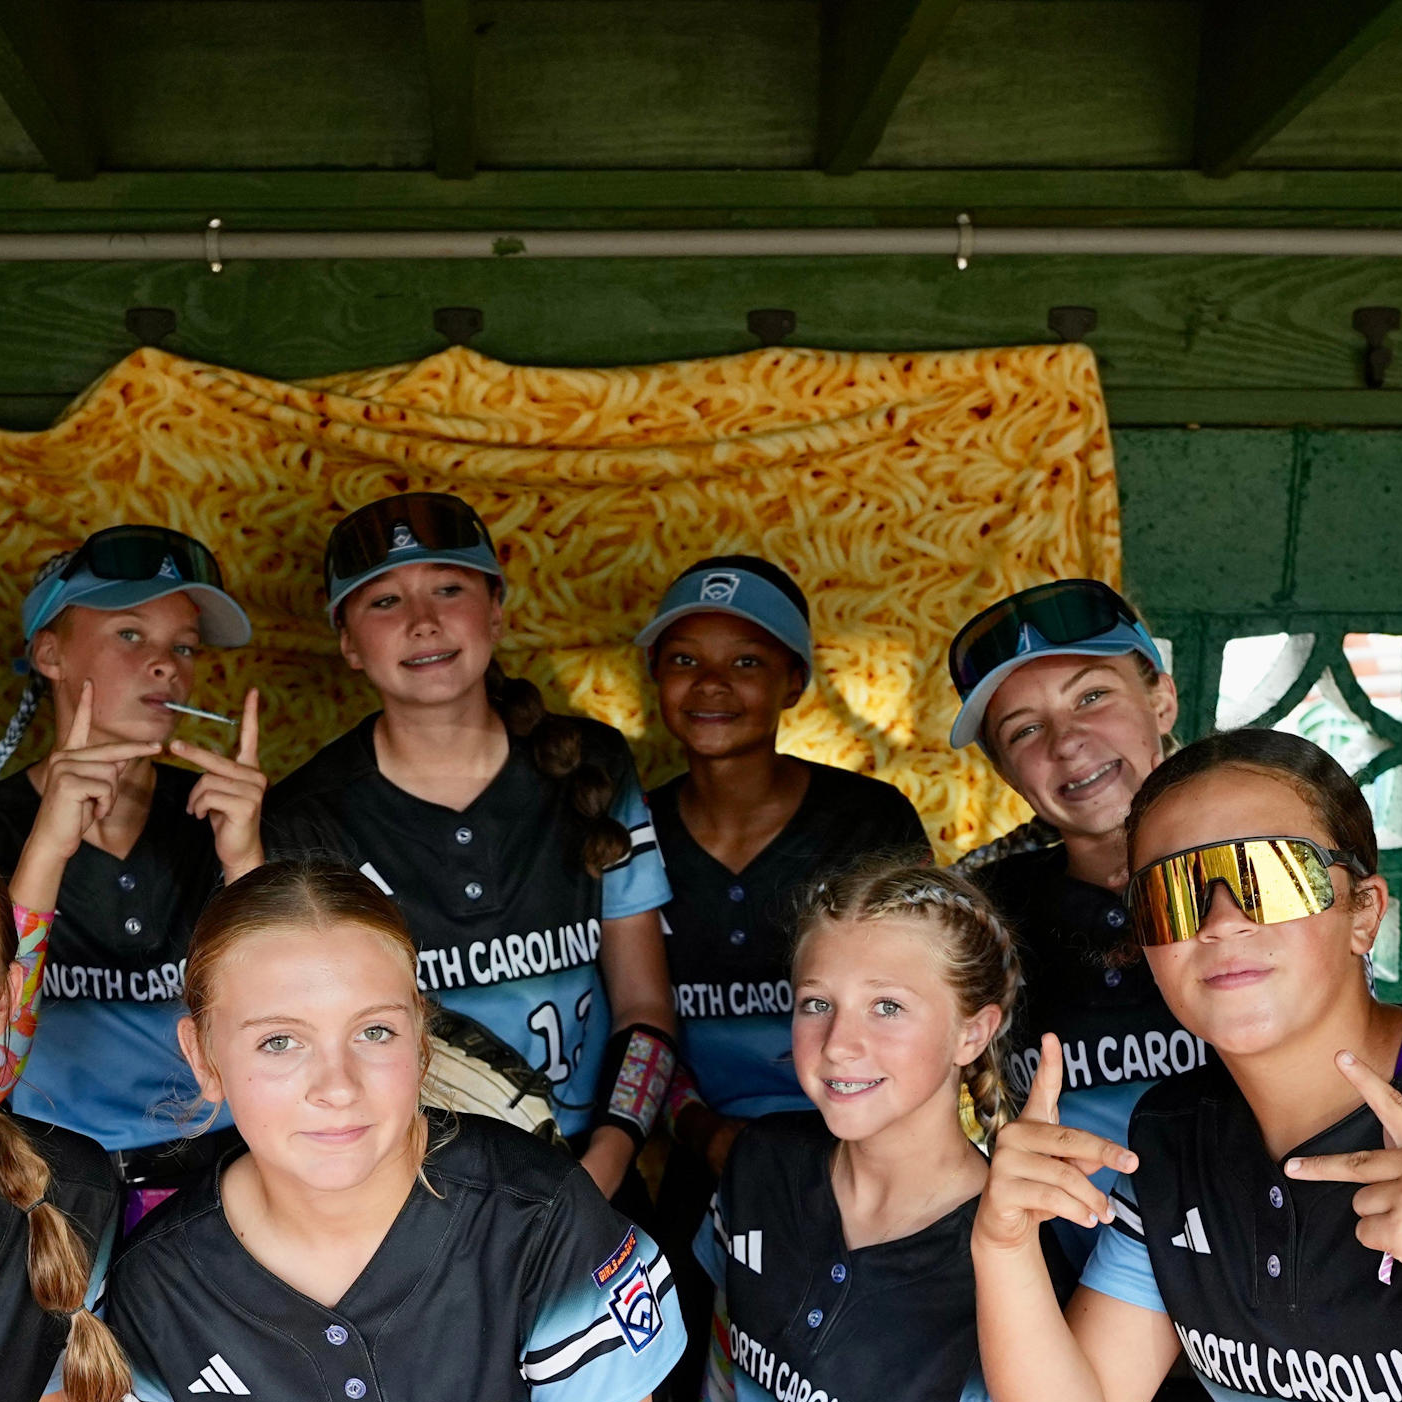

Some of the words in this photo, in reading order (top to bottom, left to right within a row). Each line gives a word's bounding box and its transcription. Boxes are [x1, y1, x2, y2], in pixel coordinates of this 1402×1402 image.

[42, 961, 124, 1000] NORTH
[468, 917, 601, 985] CAROLINA
[729, 978, 794, 1016] CARO
[526, 986, 594, 1085] 1
[729, 1322, 776, 1390] ORTH
[1175, 1321, 1267, 1396] NORTH
